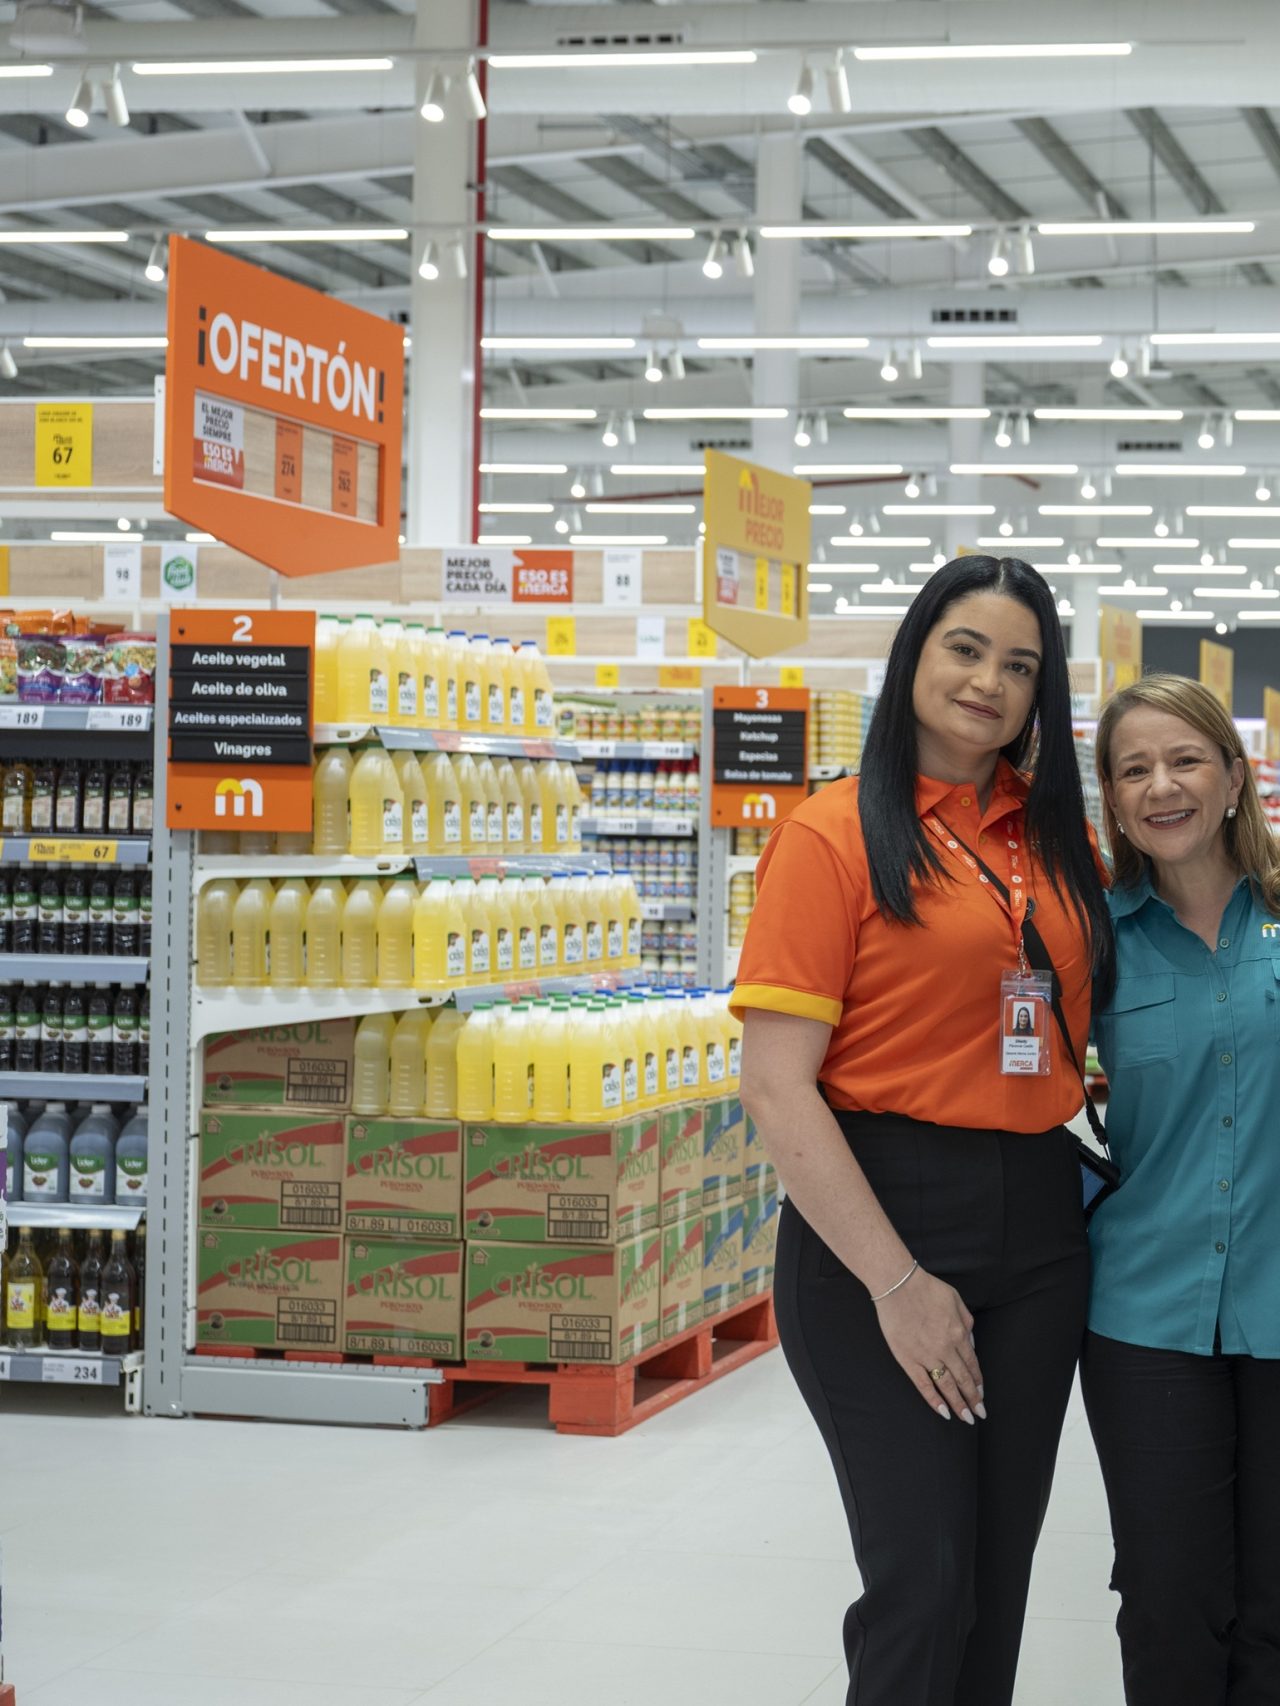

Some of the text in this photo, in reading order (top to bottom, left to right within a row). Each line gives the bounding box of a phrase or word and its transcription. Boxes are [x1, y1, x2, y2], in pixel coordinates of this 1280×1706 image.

[197, 305, 385, 424] ¡OFERTÓN!
[202, 402, 233, 420] EL MEJOR
[205, 416, 230, 430] PRECIO
[202, 425, 232, 443] SIEMPRE
[53, 447, 73, 465] 67
[203, 442, 233, 462] ESO ES
[447, 559, 491, 568] MEJOR
[447, 571, 493, 580] PRECIO
[519, 570, 568, 582] ESO ES
[446, 579, 507, 593] CADA DÍA
[232, 615, 253, 642] 2
[192, 652, 286, 669] Aceite vegetal
[191, 682, 288, 697] Aceite de oliva
[756, 688, 769, 709] 3
[16, 712, 38, 725] 189
[120, 714, 142, 727] 189
[174, 712, 302, 727] Aceites especializados
[733, 712, 783, 724] Mayonesas
[739, 731, 779, 743] Ketchup
[214, 742, 272, 759] Vinagres
[739, 751, 778, 762] Especias
[93, 847, 109, 859] 67
[223, 1136, 322, 1168] CRISOL
[354, 1148, 450, 1180] CRISOL
[490, 1151, 590, 1179] CRISOL
[292, 1184, 330, 1195] 016033
[559, 1197, 598, 1208] 016033
[350, 1218, 386, 1231] 8/1.89
[407, 1220, 449, 1233] 016033
[222, 1253, 319, 1285] CRISOL
[354, 1267, 450, 1301] CRISOL
[491, 1270, 592, 1300] CRISOL
[288, 1301, 326, 1312] 016033
[561, 1317, 601, 1328] 016033
[350, 1337, 386, 1350] 8/1.89
[407, 1341, 450, 1352] 016033
[73, 1366, 97, 1380] 234
